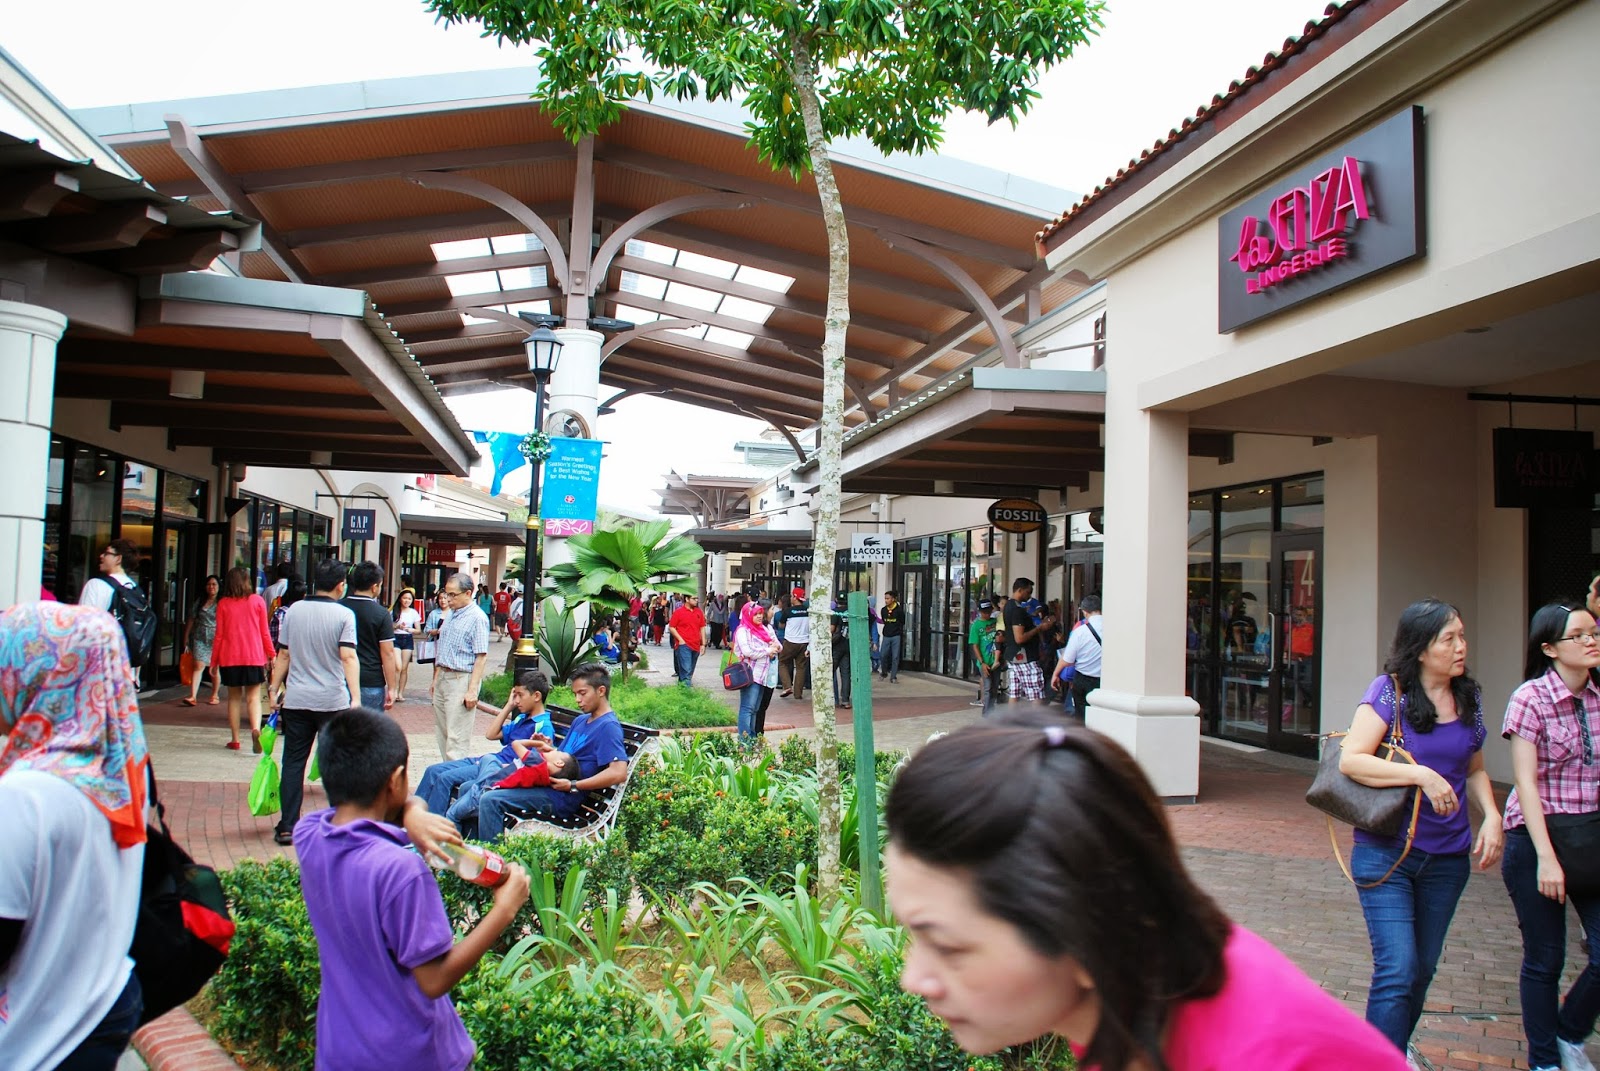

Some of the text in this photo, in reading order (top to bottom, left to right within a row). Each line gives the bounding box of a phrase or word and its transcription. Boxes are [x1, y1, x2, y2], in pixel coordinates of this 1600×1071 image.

[1246, 237, 1347, 294] LINGERIE
[350, 515, 368, 529] GAP
[994, 509, 1042, 522] FOSSIL
[853, 547, 891, 555] LACOSTE
[754, 558, 766, 571] ck
